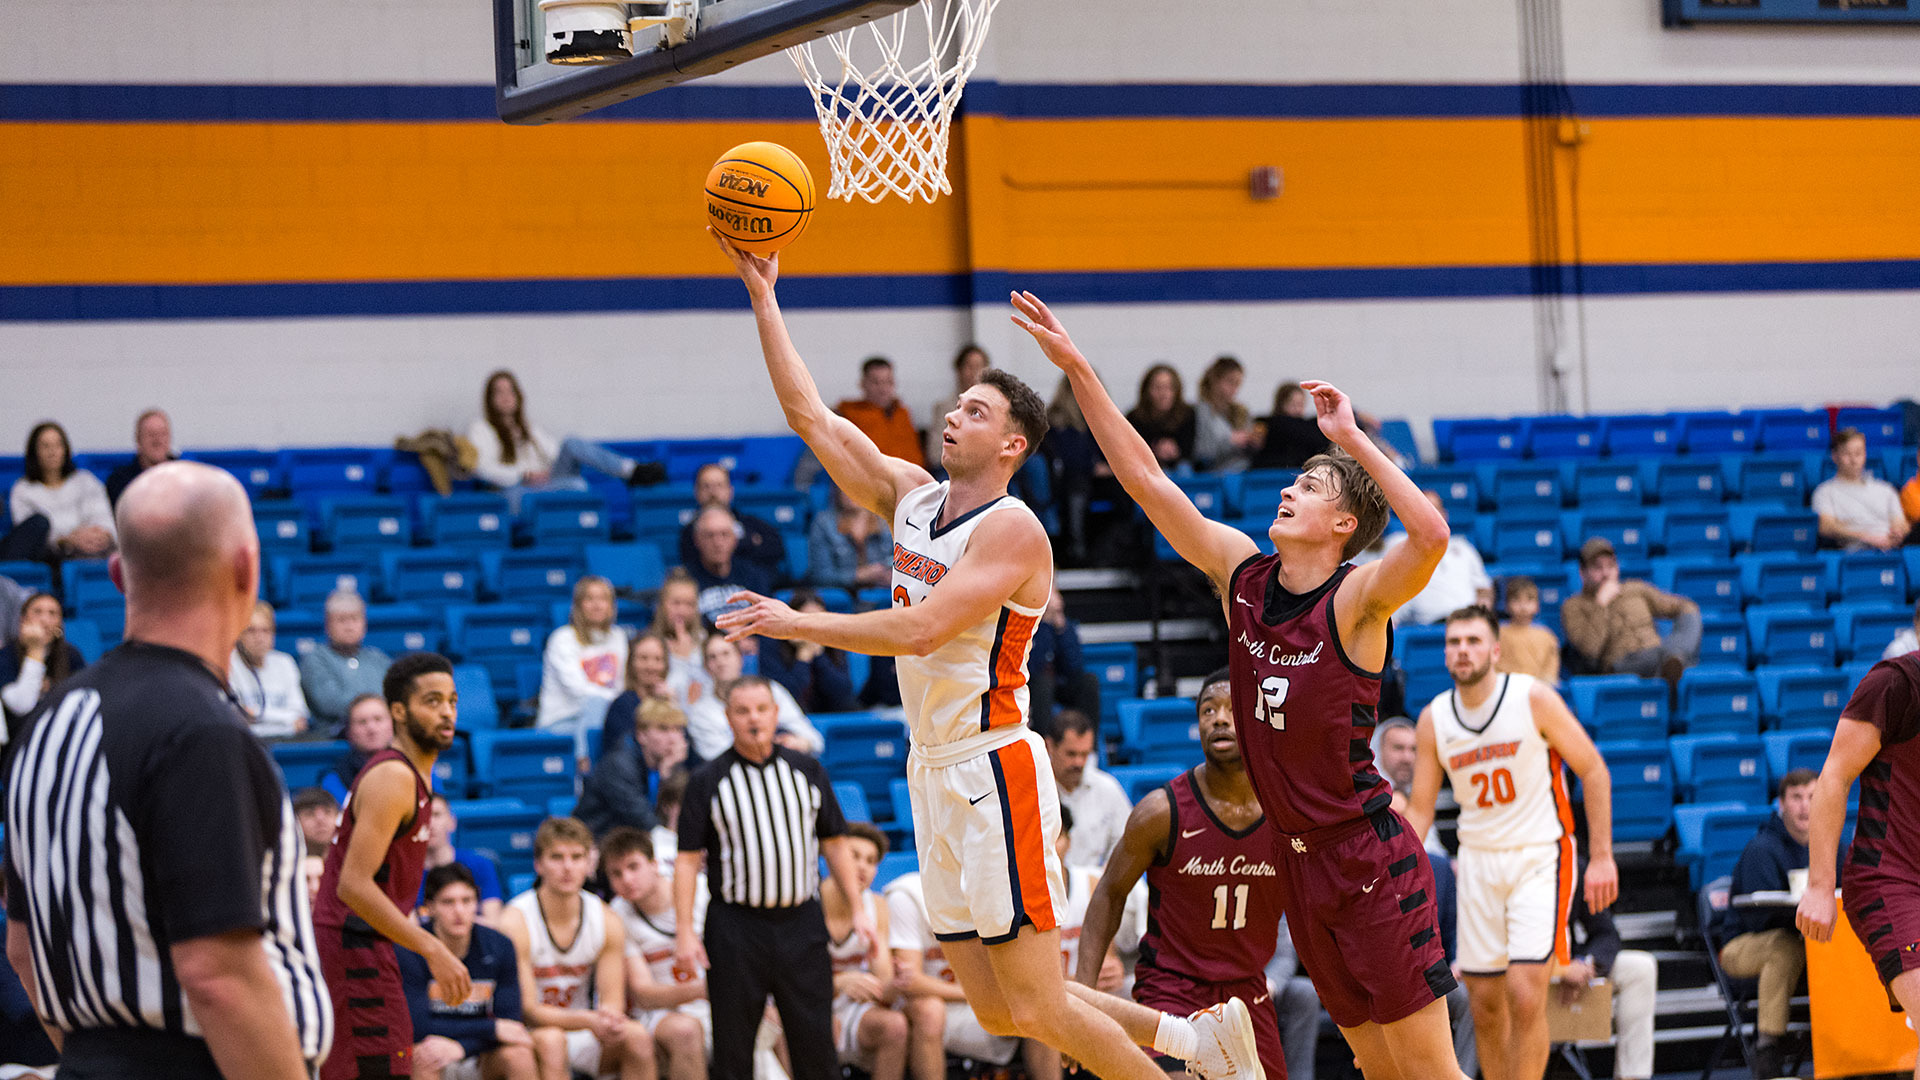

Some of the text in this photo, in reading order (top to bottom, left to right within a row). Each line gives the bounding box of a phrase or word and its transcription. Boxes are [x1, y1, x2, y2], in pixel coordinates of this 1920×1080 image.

[719, 172, 771, 198] NCAA
[707, 200, 774, 234] Wilson
[1253, 670, 1287, 732] 12
[1470, 767, 1517, 809] 20
[1178, 854, 1277, 877] North Centra
[1211, 883, 1250, 931] 11
